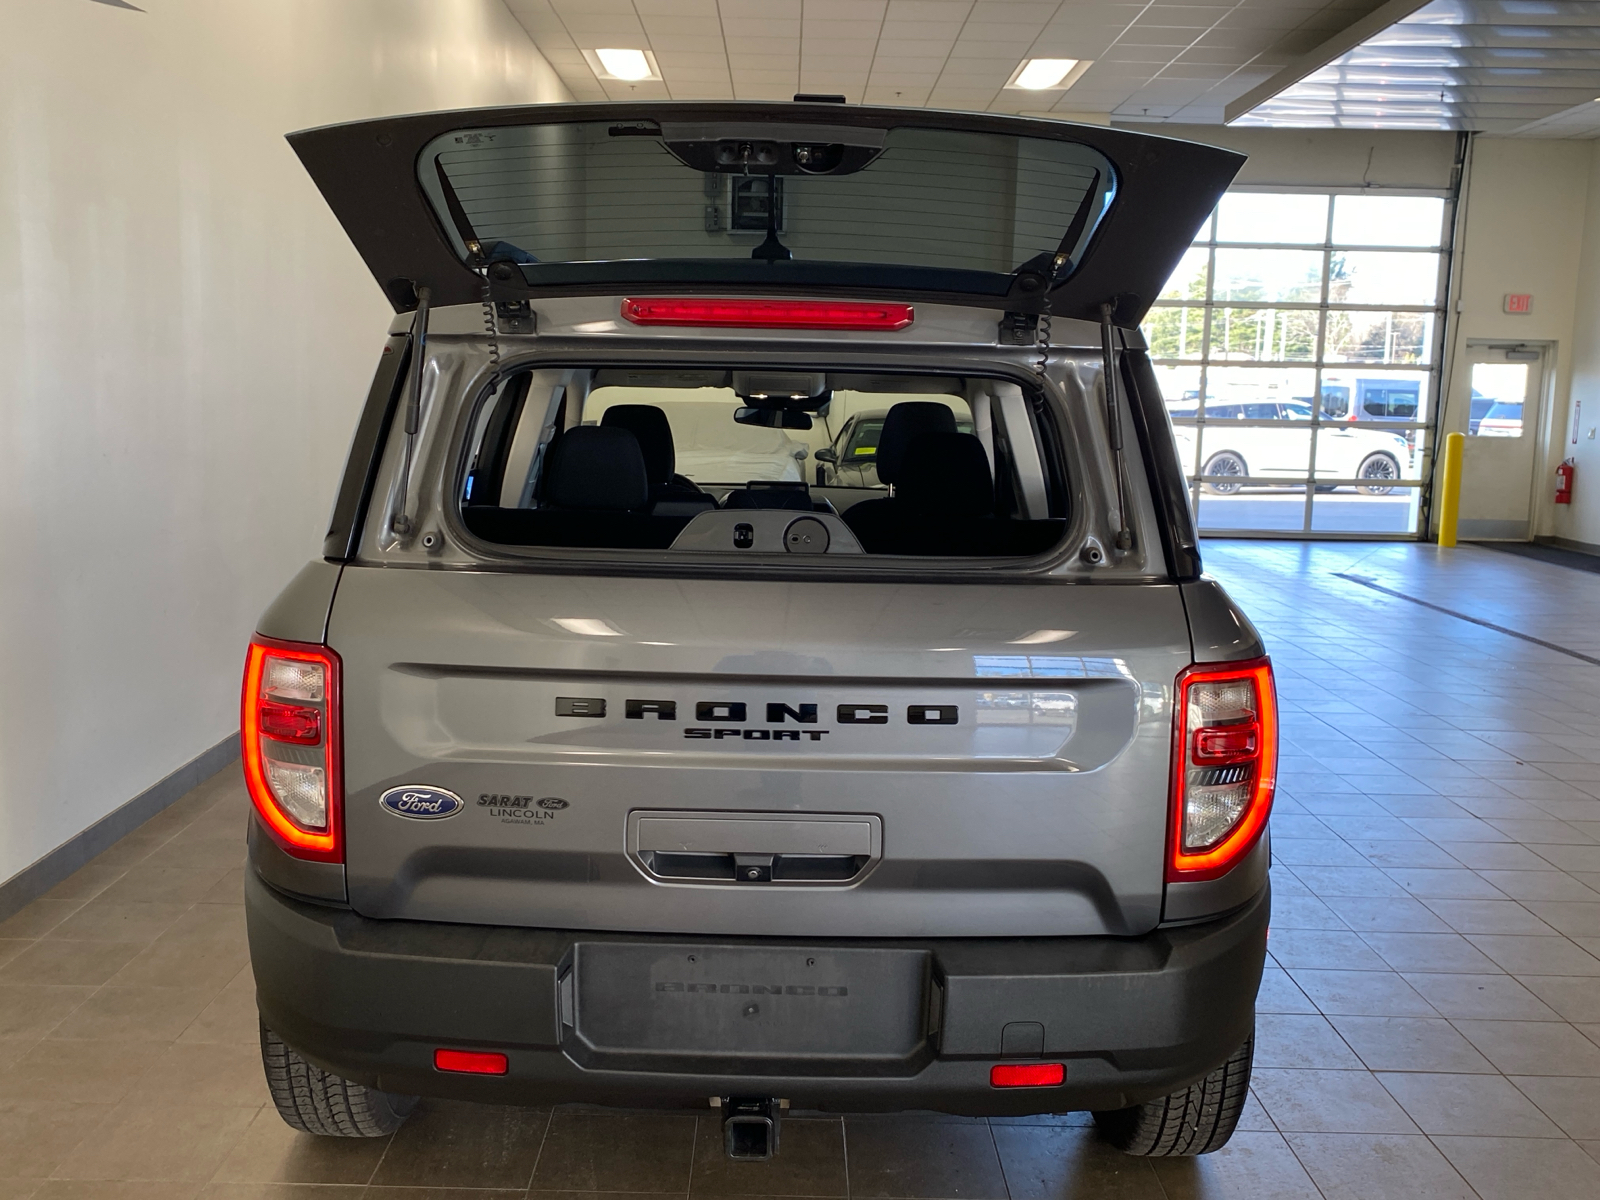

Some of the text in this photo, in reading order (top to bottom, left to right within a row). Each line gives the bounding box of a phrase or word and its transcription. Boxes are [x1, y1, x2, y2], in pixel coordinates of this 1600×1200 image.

[1509, 294, 1530, 311] EXIT
[555, 696, 959, 725] BRONCO
[684, 728, 830, 741] SPORT
[397, 792, 443, 812] Ford
[476, 794, 533, 809] SARAT
[490, 808, 554, 819] LINCOLN
[655, 982, 848, 996] BRONCO
